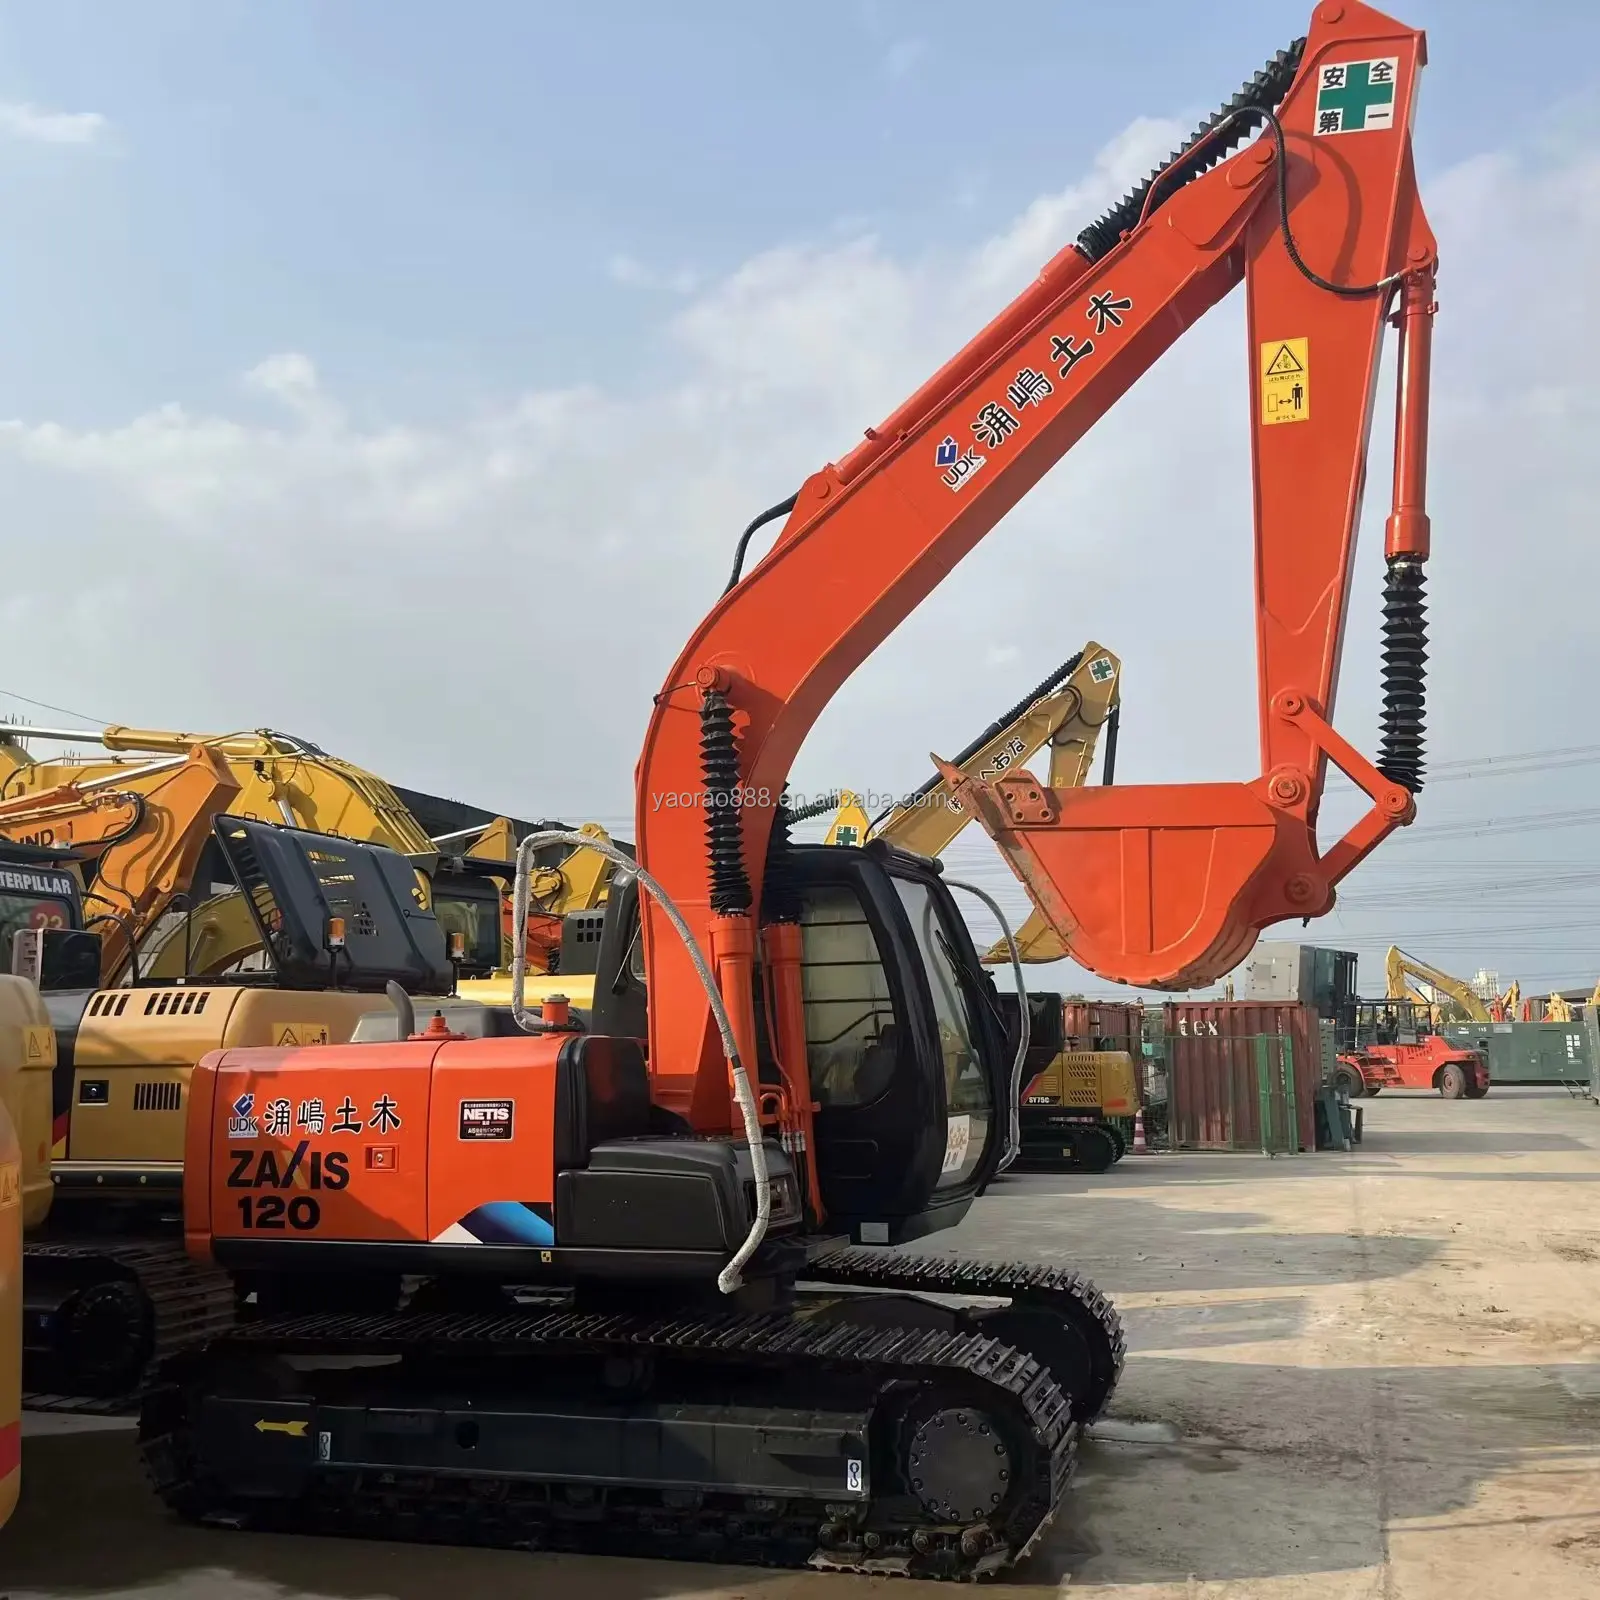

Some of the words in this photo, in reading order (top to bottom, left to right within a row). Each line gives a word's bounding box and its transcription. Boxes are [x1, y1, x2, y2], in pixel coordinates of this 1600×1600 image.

[941, 446, 983, 487] UDK
[229, 1117, 258, 1132] UDK
[463, 1108, 510, 1121] NETIS
[227, 1140, 350, 1191] ZAXIS
[237, 1195, 321, 1231] 120
